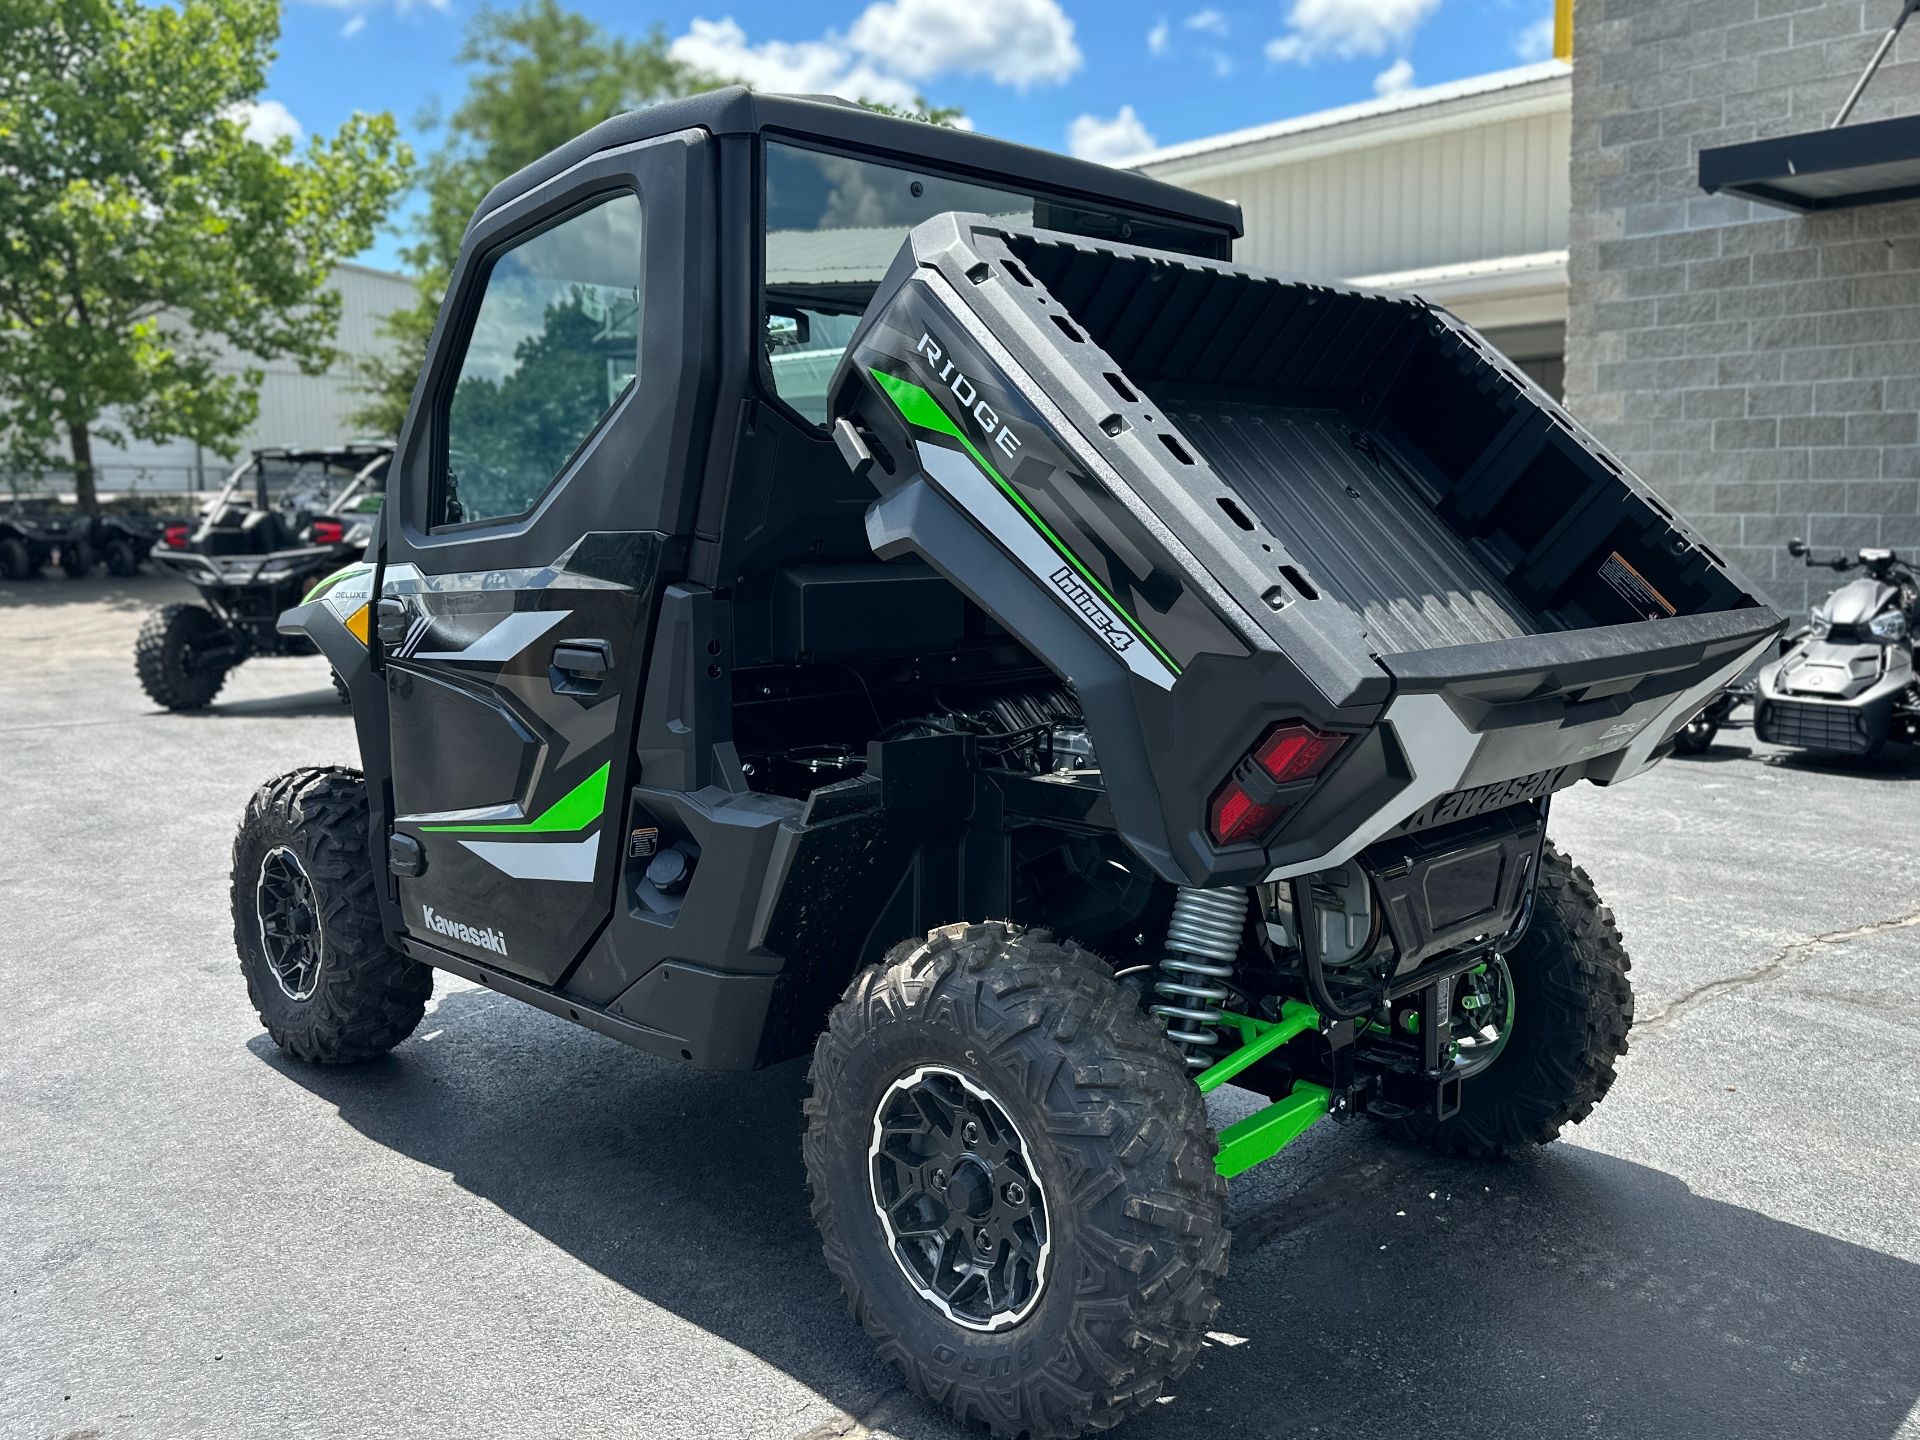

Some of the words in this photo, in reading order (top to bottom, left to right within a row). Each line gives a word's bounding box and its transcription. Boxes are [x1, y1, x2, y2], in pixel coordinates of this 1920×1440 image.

[918, 333, 1022, 458] RIDGE
[335, 591, 368, 599] DELUXE
[1050, 565, 1135, 652] Inline-4
[422, 904, 508, 956] Kawasaki
[932, 1343, 1033, 1378] DURO
